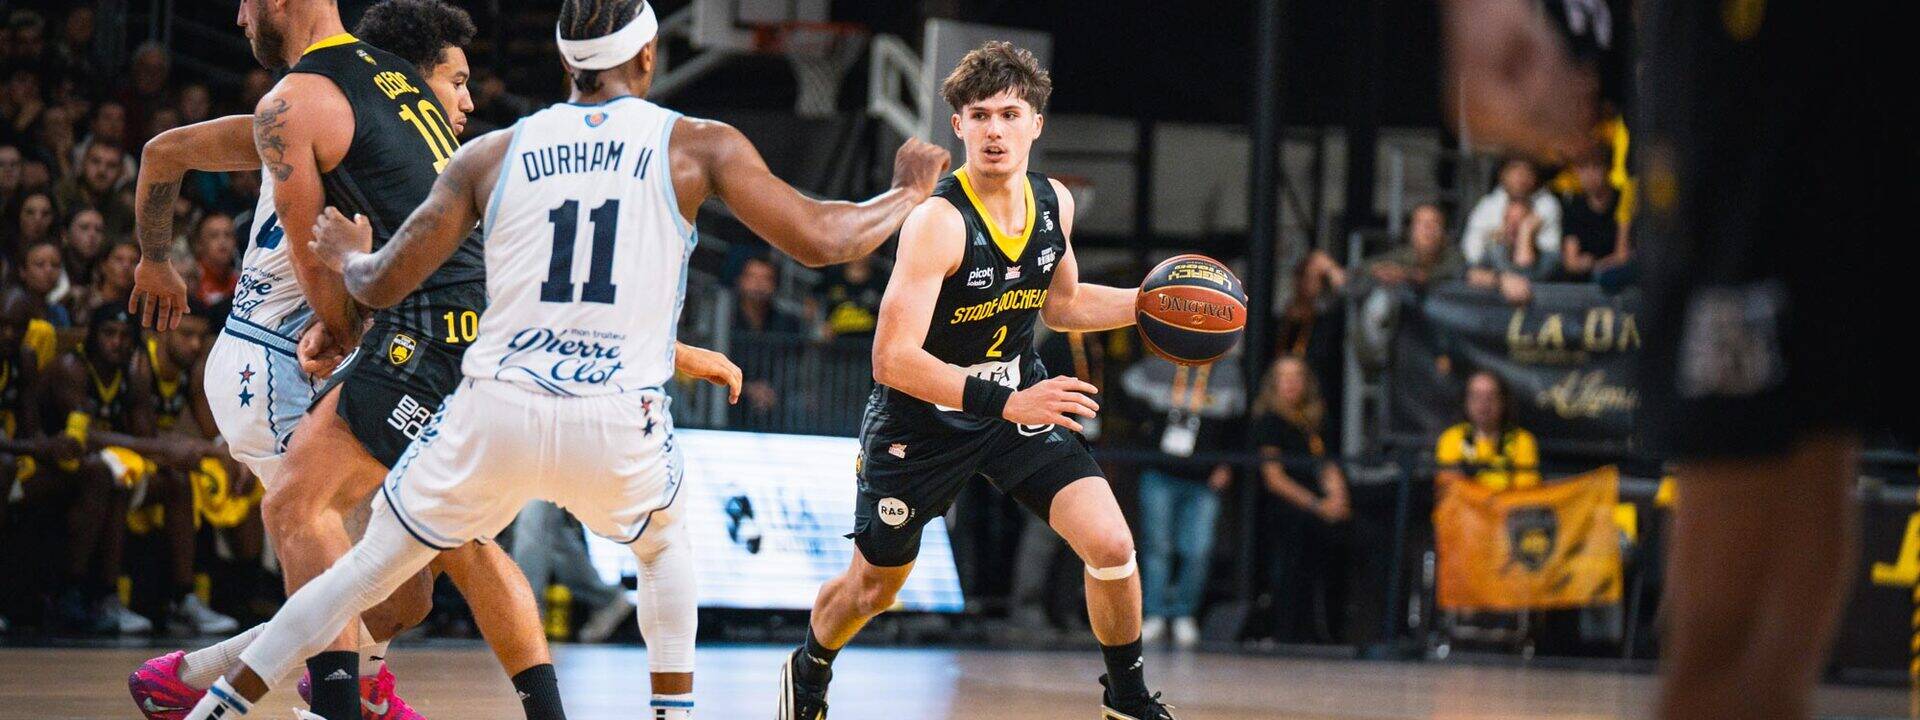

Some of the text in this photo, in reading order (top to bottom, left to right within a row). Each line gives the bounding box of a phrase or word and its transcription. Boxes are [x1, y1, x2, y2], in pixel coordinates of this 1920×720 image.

[399, 99, 462, 175] 10
[522, 140, 625, 183] DURHAM
[540, 198, 620, 305] 11
[950, 289, 1049, 325] STADE ROCHELA
[1158, 293, 1236, 323] SPALDING
[443, 310, 479, 344] 10
[985, 325, 1008, 358] 2
[499, 327, 621, 367] Pierre
[550, 357, 624, 386] Clot
[397, 394, 434, 425] BA
[881, 505, 905, 516] RAS
